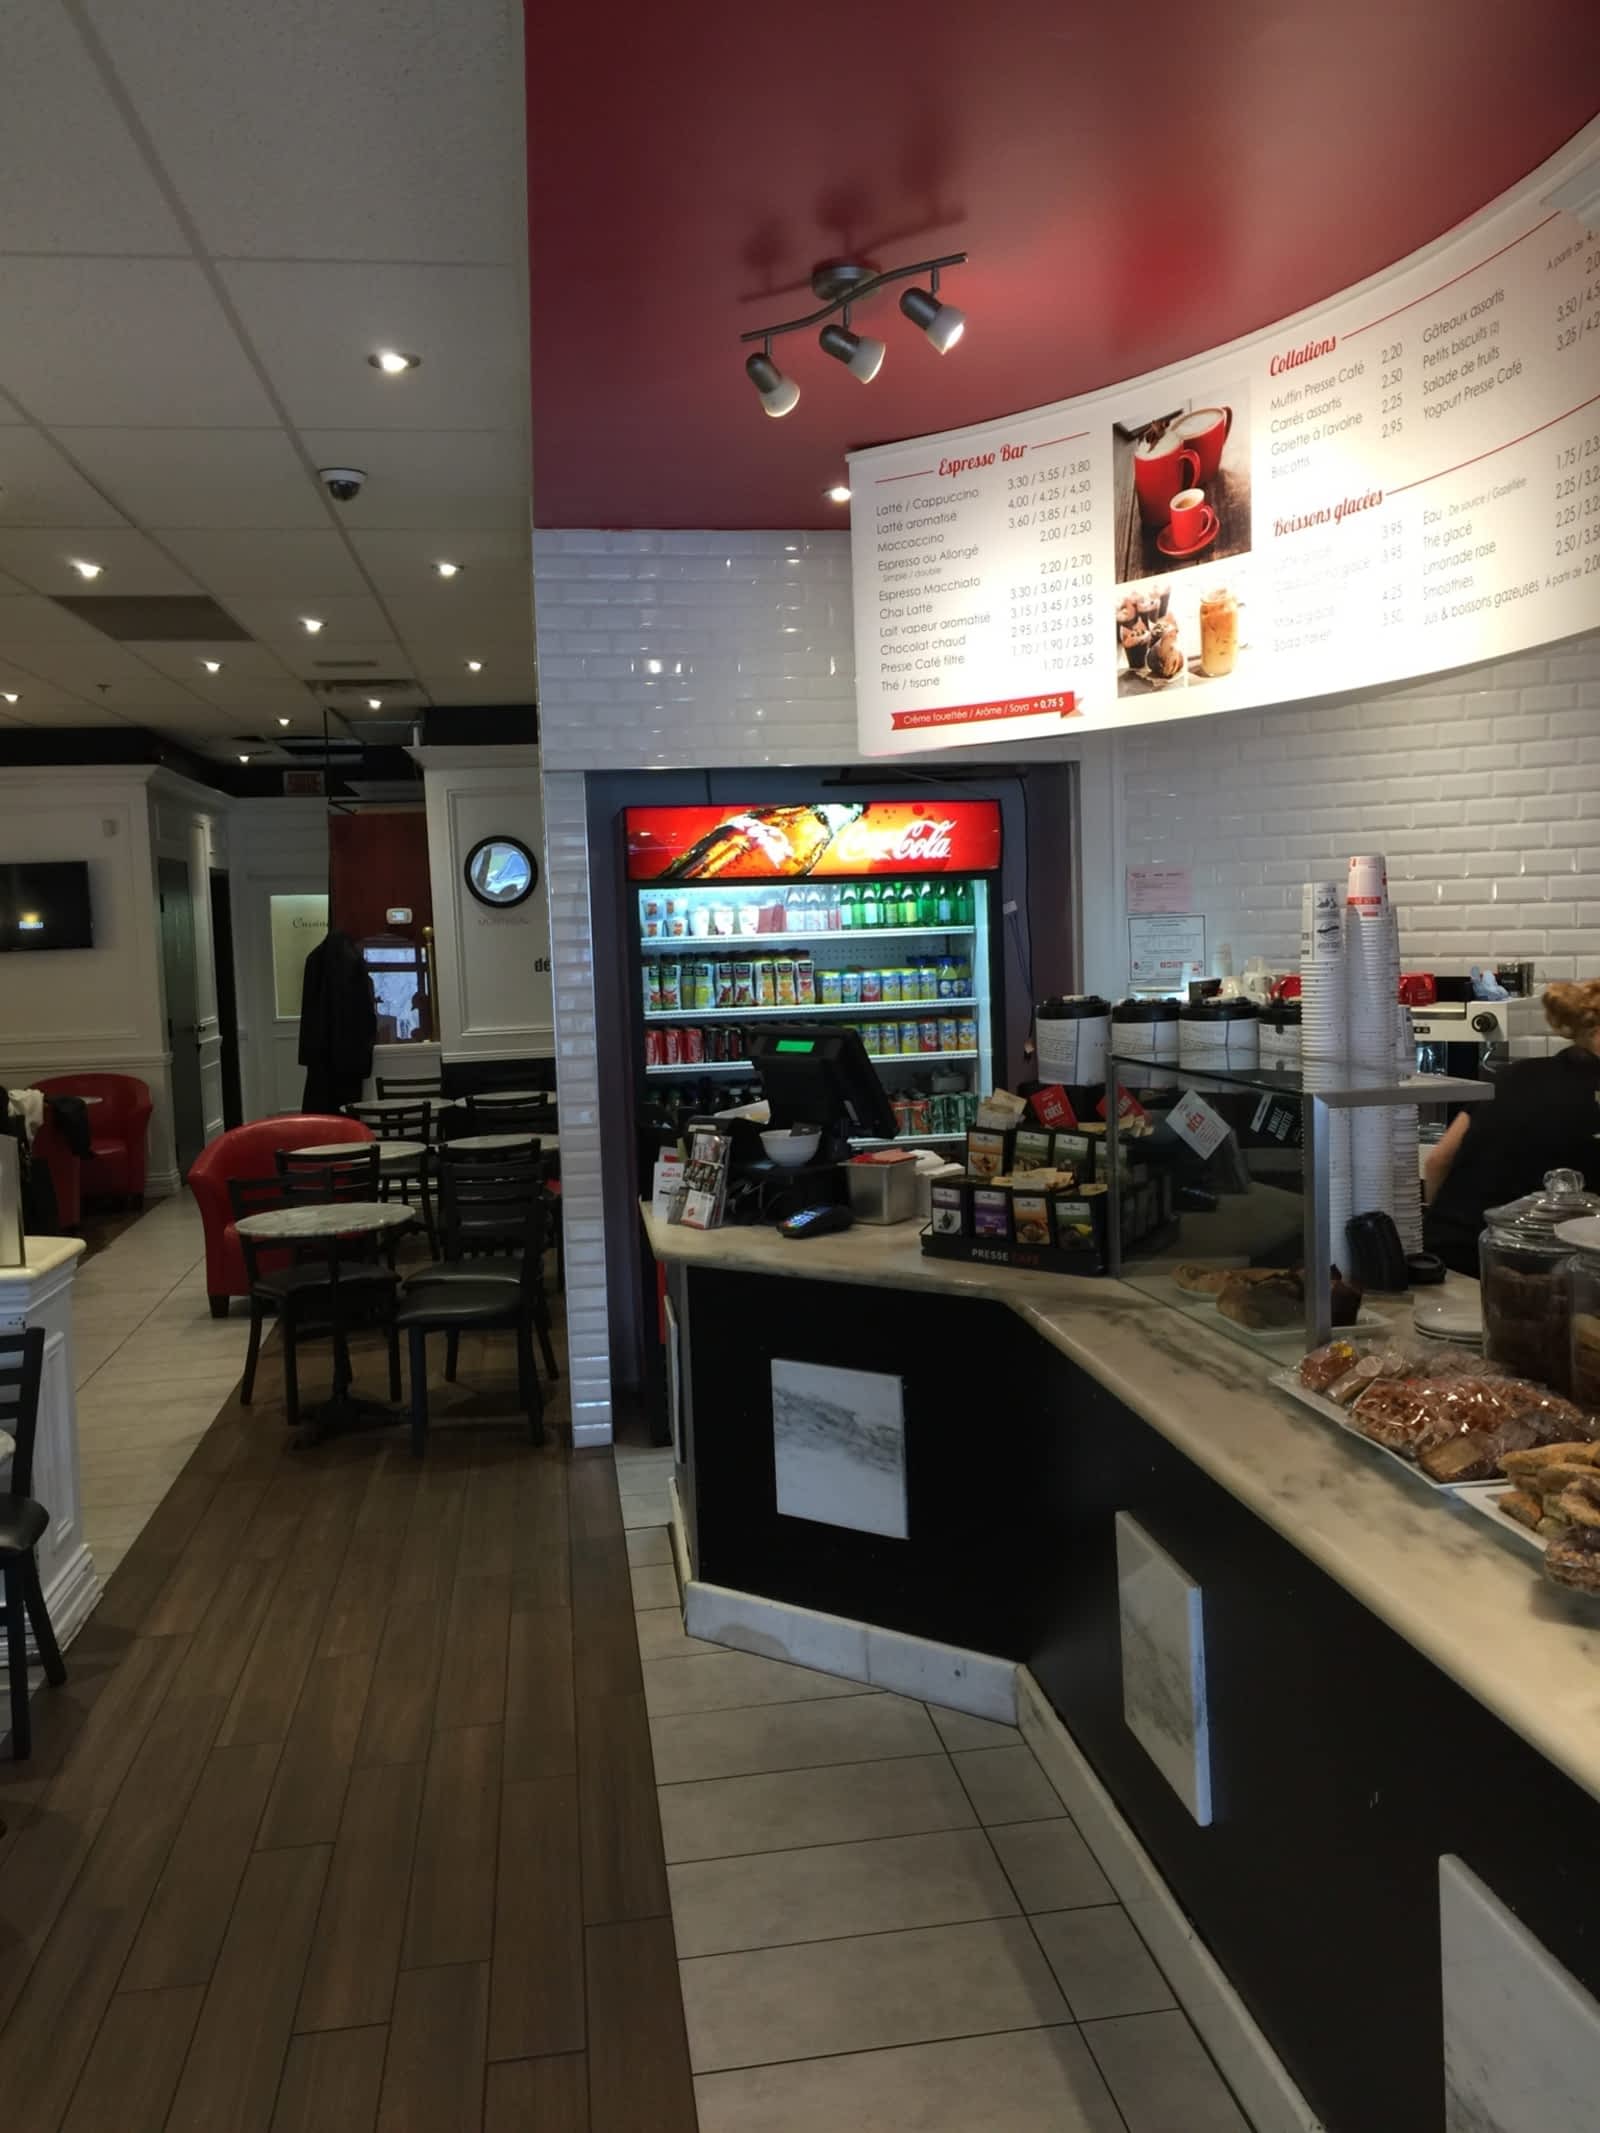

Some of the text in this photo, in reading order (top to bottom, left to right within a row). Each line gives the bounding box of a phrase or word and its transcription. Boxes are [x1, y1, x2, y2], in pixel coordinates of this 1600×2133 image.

[1270, 336, 1336, 376] Collations
[1424, 346, 1449, 368] Petits
[1451, 325, 1487, 355] biscuits
[1424, 346, 1500, 395] Salade de fruits
[1464, 377, 1494, 400] Presse
[1497, 358, 1522, 384] Café
[1271, 362, 1365, 410] Muffin Presse Café
[1270, 411, 1304, 433] Carrés
[1271, 433, 1311, 456] Galette
[938, 443, 1029, 477] Espresso Bar
[912, 488, 979, 509] Cappuccino
[1273, 488, 1383, 537] Boissons glacées
[1424, 508, 1442, 526] Eau
[1443, 519, 1473, 548] glacé
[878, 544, 979, 572] Espresso ou Allongé
[1424, 547, 1473, 576] Limonade
[1475, 540, 1496, 560] rose
[878, 577, 981, 603] Espresso Macchiato
[1424, 573, 1474, 601] Smoothies
[1451, 593, 1492, 619] boissons
[1494, 578, 1540, 609] gazeuses
[879, 607, 904, 620] Chai
[880, 611, 991, 639] Lait vapeur aromatisé
[880, 634, 966, 656] Chocolat chaud
[880, 654, 966, 673] Presse Café filtre
[881, 679, 899, 692] Thé
[910, 676, 940, 689] tisane
[903, 712, 932, 725] Crème
[933, 709, 968, 722] fouettée
[975, 706, 1002, 717] Arôme
[1058, 696, 1065, 708] $
[971, 1247, 1009, 1262] PRESSE
